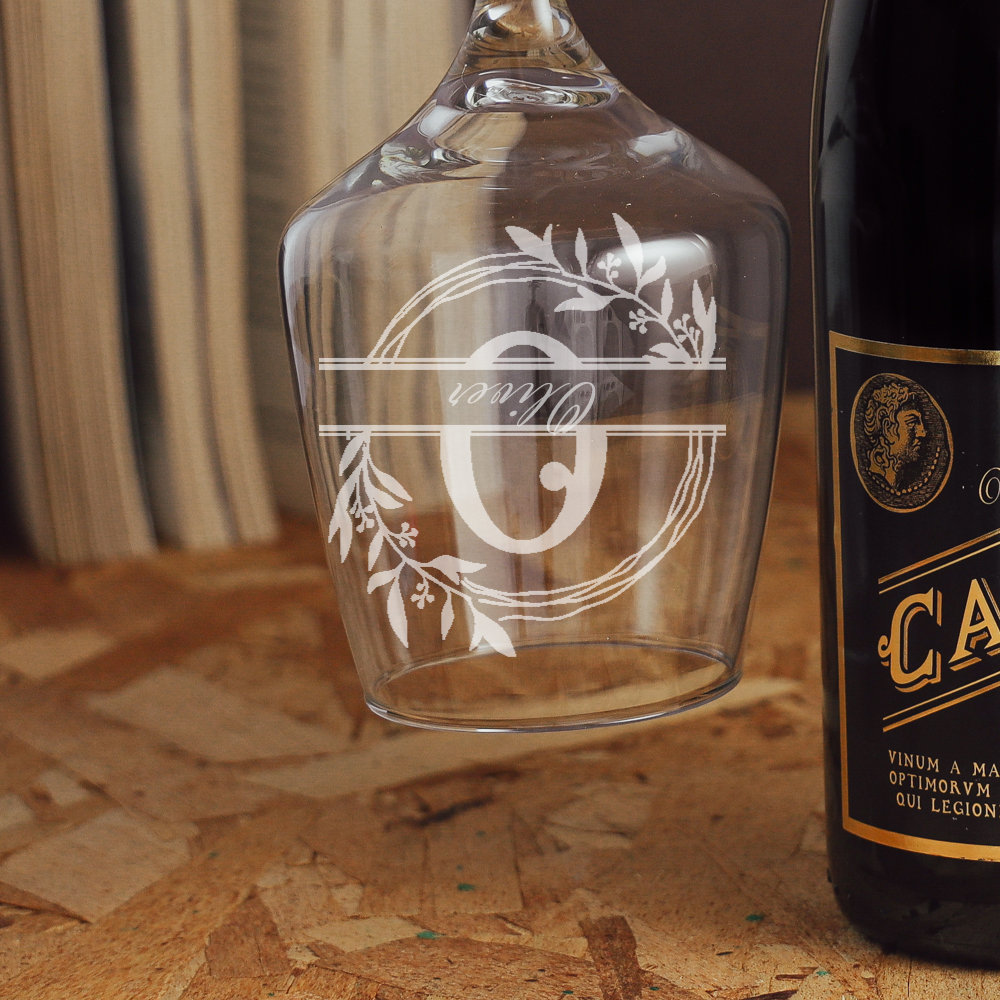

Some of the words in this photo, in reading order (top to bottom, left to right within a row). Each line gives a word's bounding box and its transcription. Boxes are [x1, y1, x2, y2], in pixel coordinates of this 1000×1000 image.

[449, 381, 596, 435] Oliver
[888, 750, 940, 773] VINUM
[950, 760, 961, 775] A
[889, 770, 991, 798] OPTIMORVM
[896, 792, 922, 810] QUI
